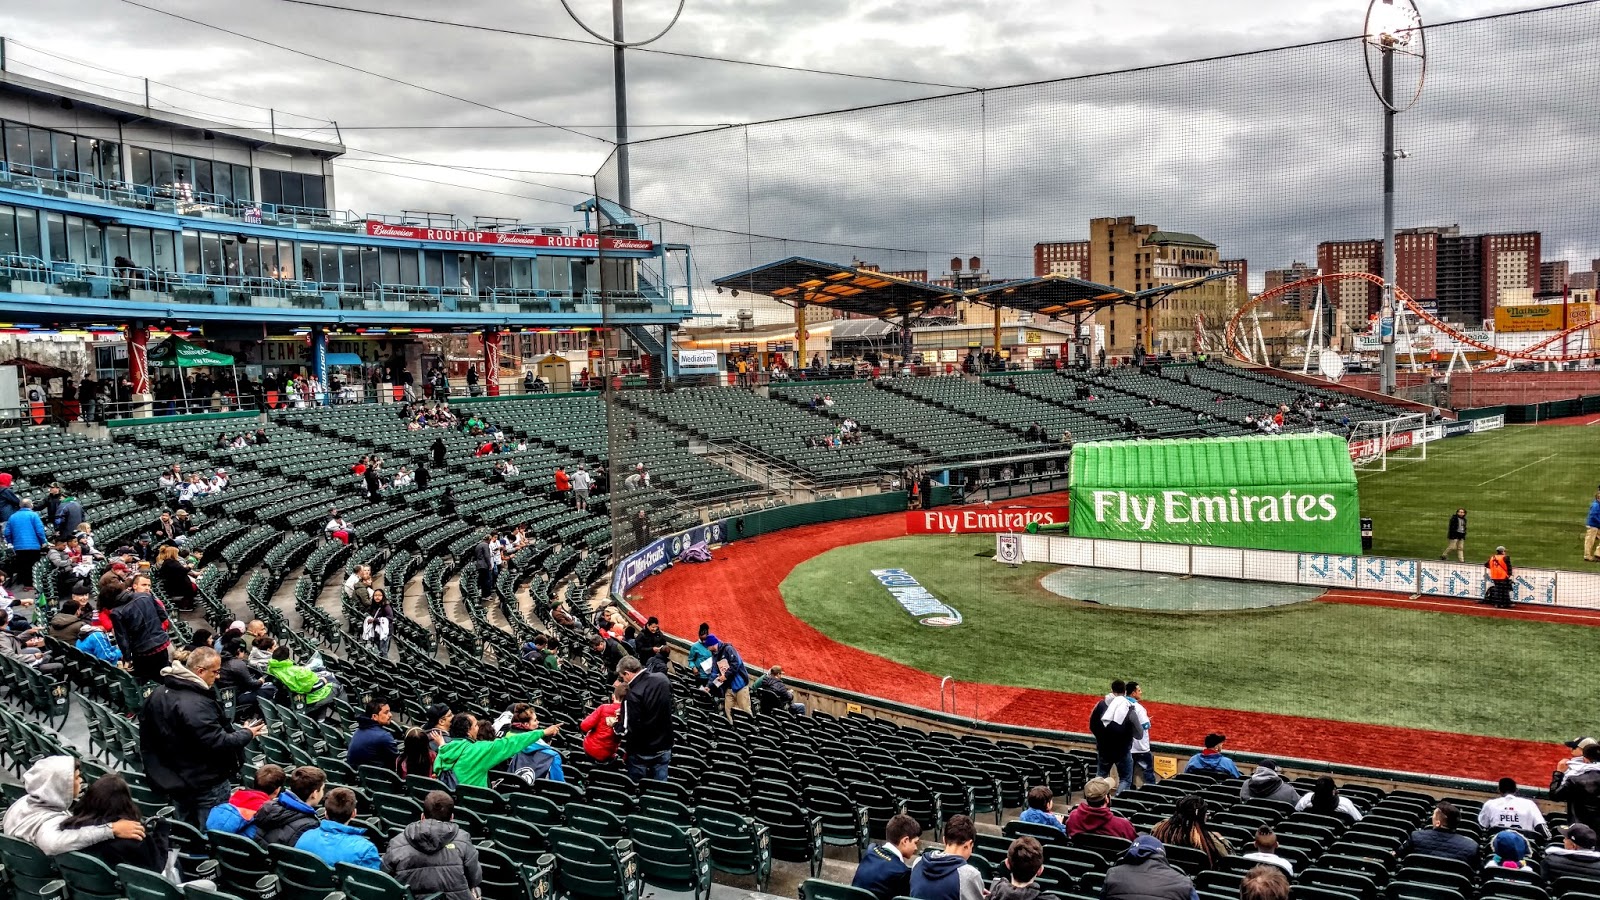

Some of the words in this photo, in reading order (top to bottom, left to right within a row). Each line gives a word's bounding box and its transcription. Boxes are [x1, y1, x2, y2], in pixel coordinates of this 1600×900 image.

[372, 225, 413, 237] Budweiser
[427, 229, 483, 242] ROOFTOP
[496, 234, 535, 245] Budweiser
[548, 236, 600, 248] ROOFTOP
[612, 239, 650, 249] Budweiser
[681, 355, 713, 363] Mediacom
[1092, 490, 1156, 530] Fly
[1162, 488, 1338, 523] Emirates
[925, 511, 960, 532] Fly
[963, 510, 1054, 529] Emirates
